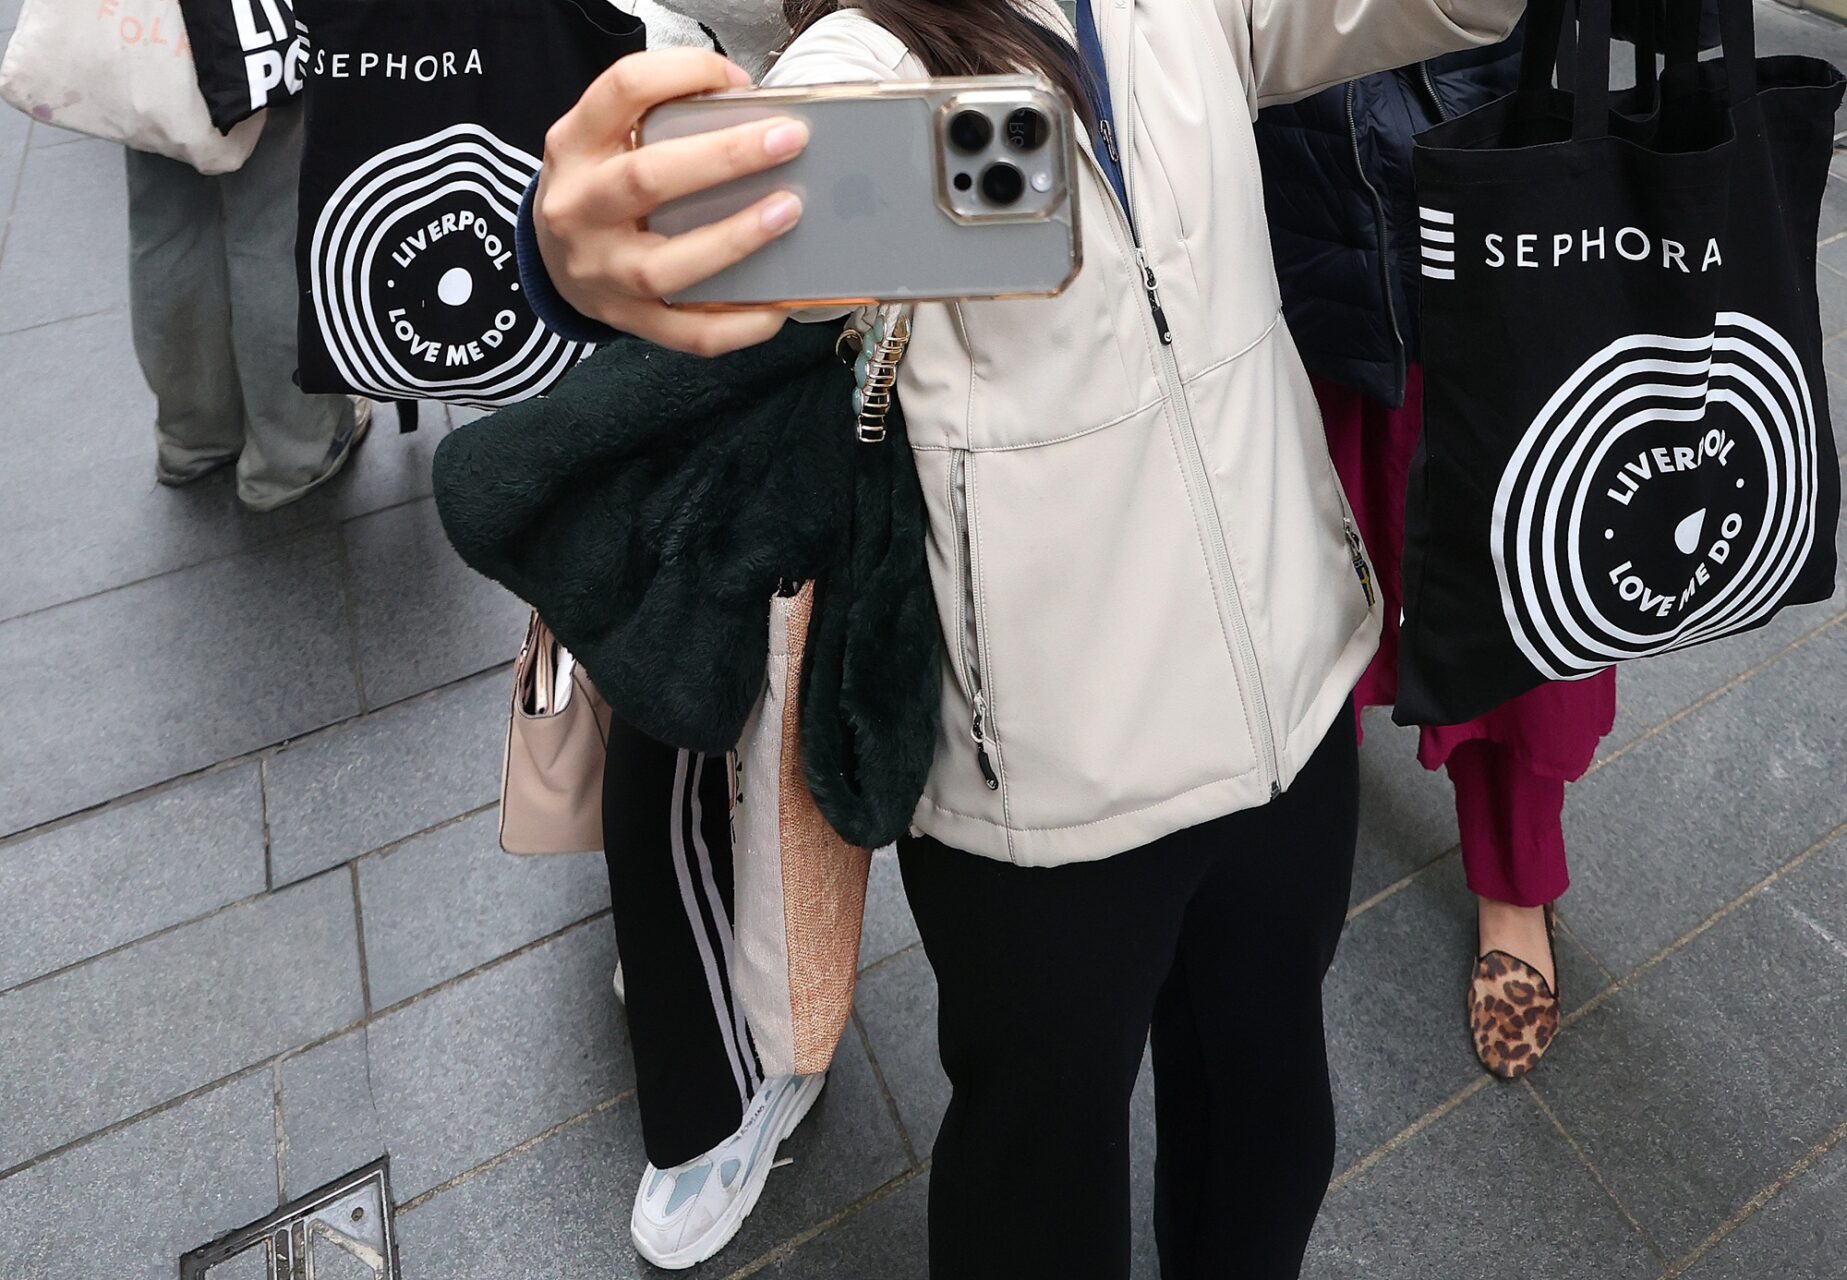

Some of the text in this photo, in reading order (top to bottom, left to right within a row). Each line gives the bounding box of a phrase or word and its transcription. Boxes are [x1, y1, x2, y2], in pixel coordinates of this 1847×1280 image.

[314, 49, 483, 82] SEPHORA
[391, 210, 513, 270] LIVERPOOL
[1485, 226, 1723, 273] SEPHORA
[388, 308, 516, 366] LOVE ME DO
[1608, 512, 1743, 617] LOVE ME DO
